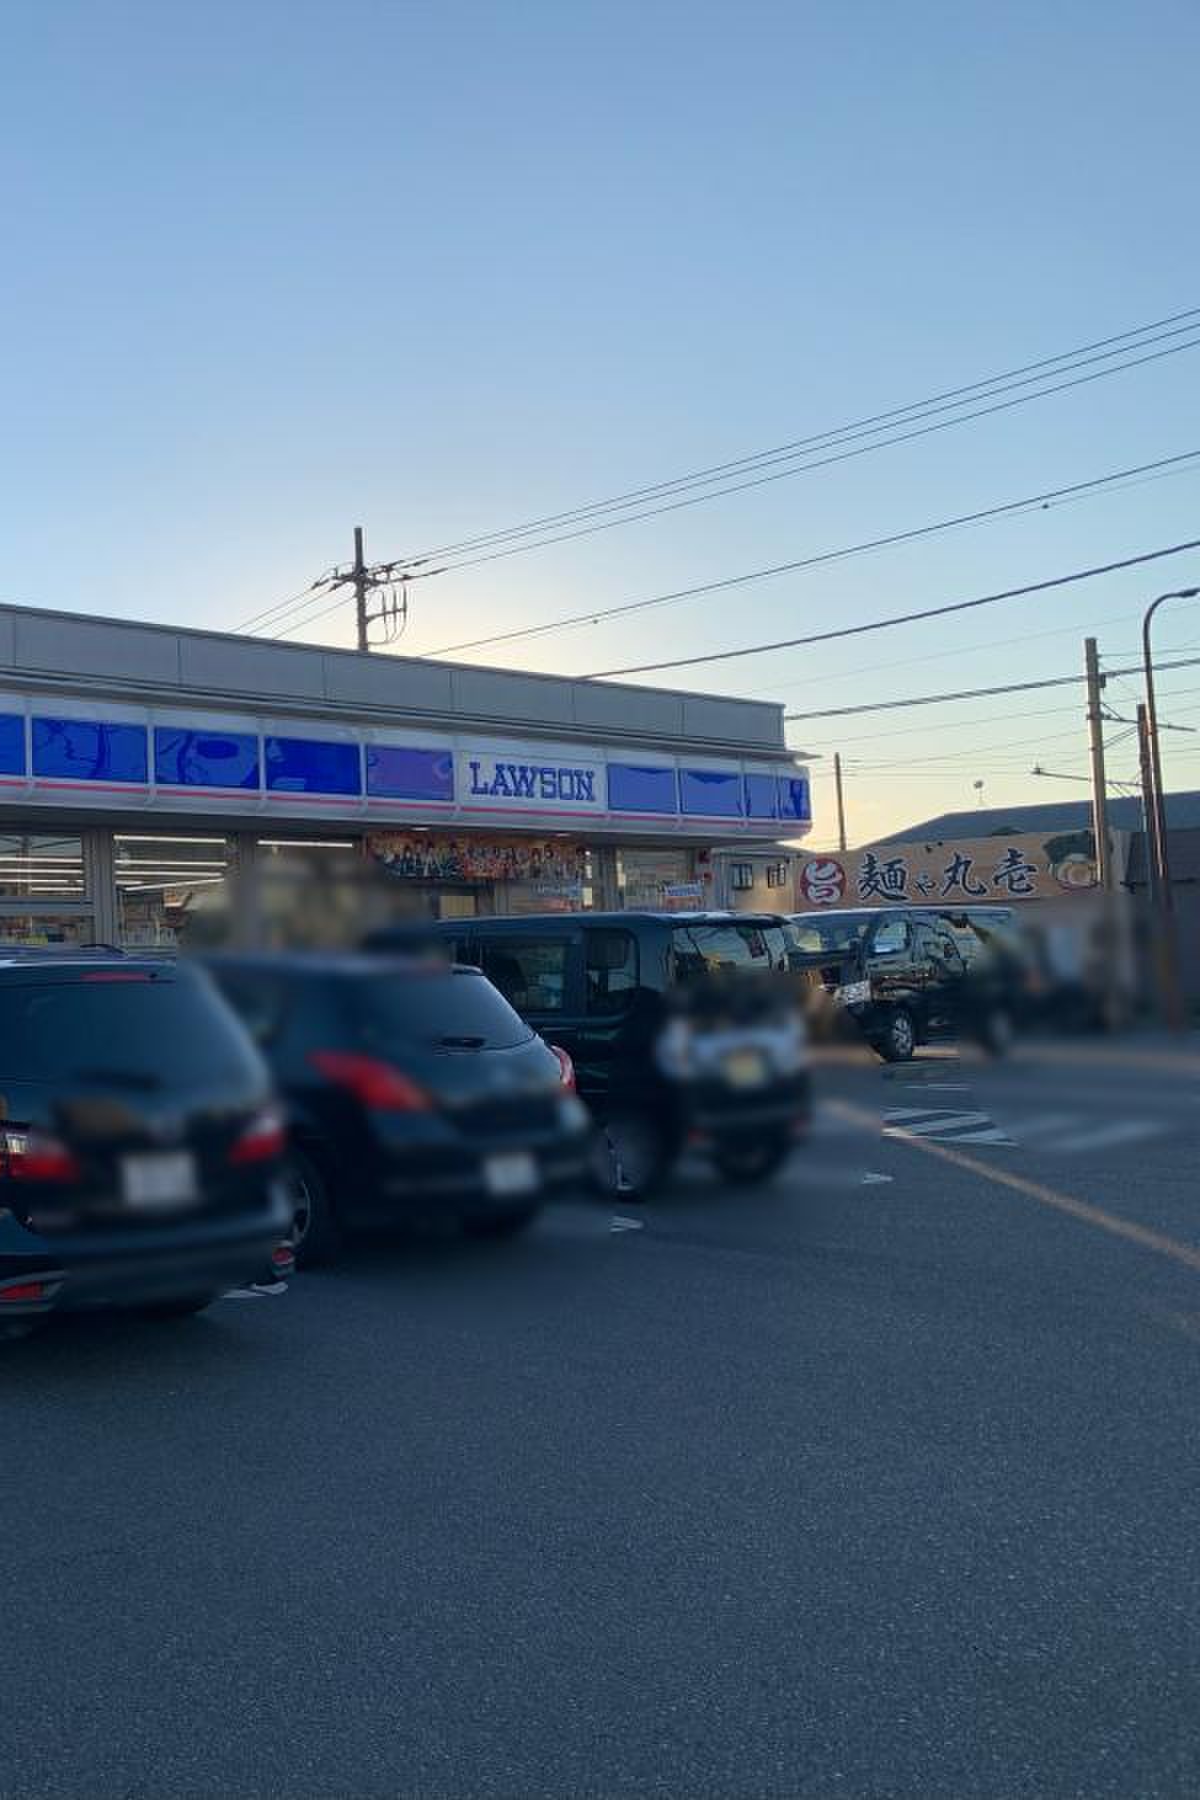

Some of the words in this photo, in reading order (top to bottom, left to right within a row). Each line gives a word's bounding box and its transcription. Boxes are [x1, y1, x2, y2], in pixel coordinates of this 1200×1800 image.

[469, 761, 596, 802] LAWSON
[857, 848, 1037, 900] 麺や丸壱
